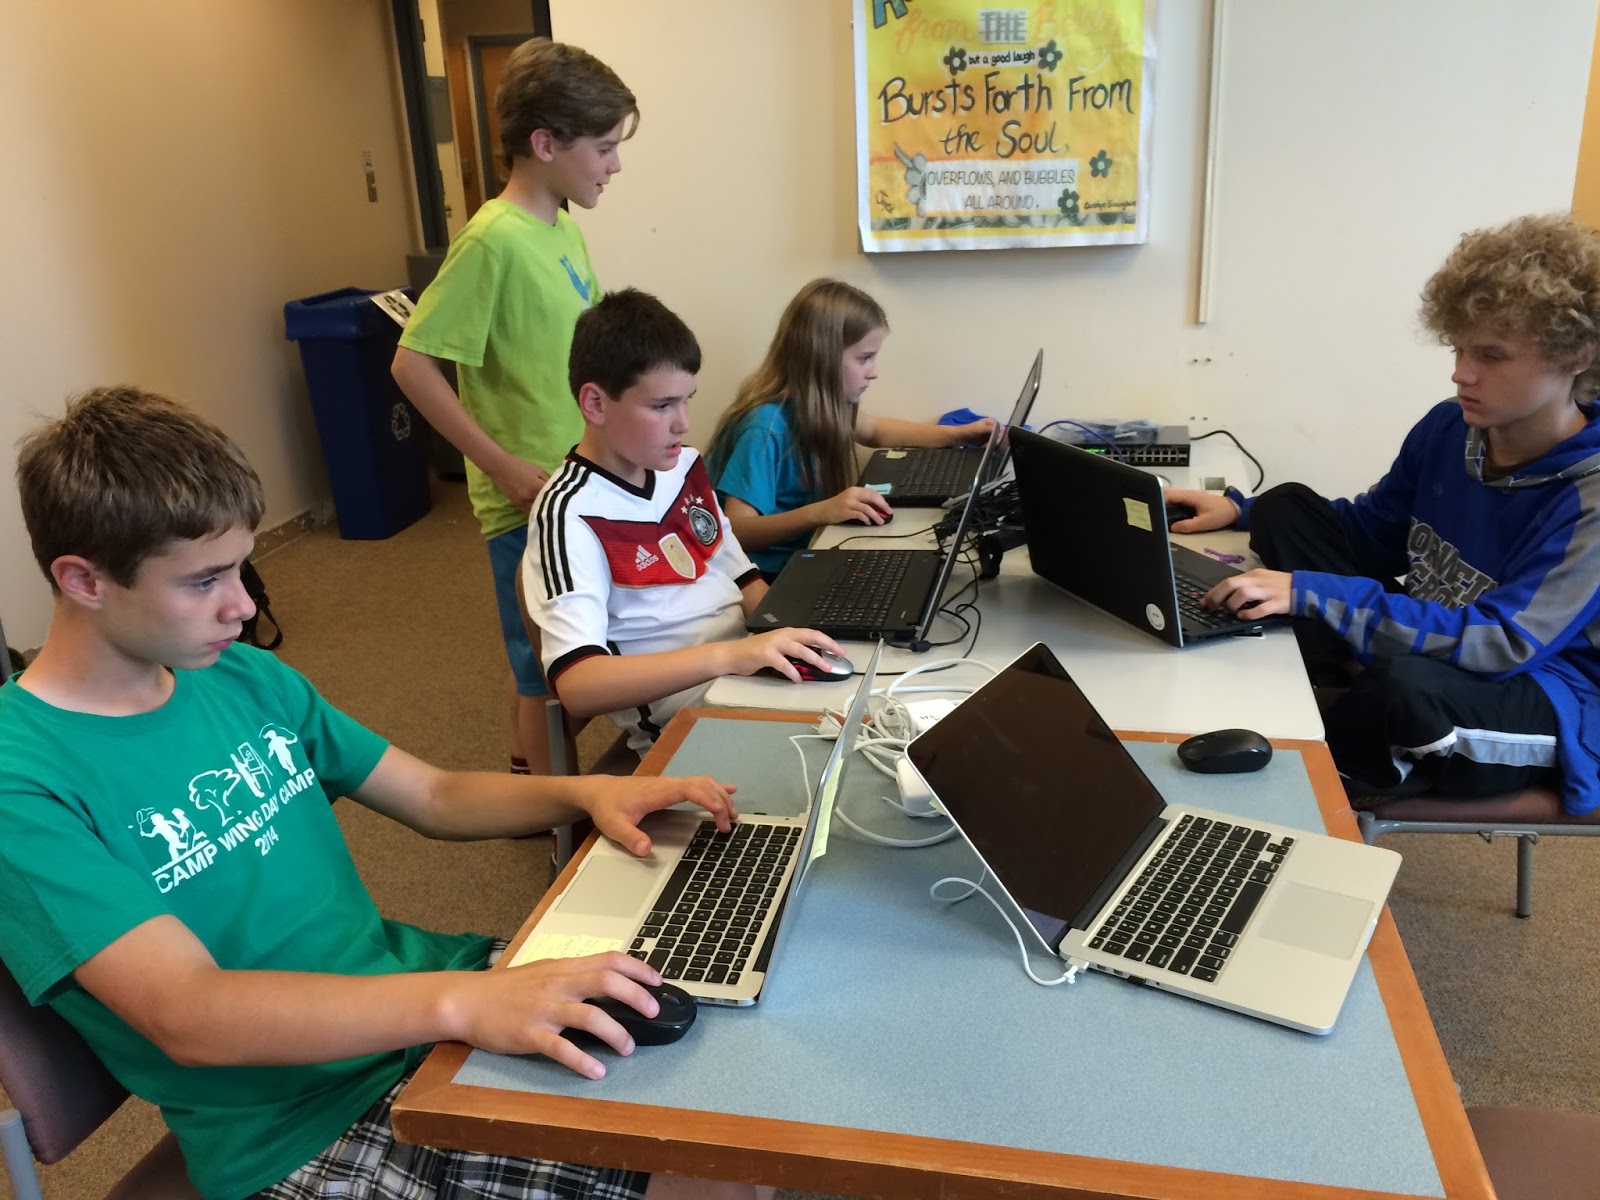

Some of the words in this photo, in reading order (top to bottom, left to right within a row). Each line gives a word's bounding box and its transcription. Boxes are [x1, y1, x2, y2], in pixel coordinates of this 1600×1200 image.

[979, 11, 1026, 42] THE
[982, 56, 989, 64] a
[991, 50, 1011, 67] good
[1013, 50, 1035, 64] laugh
[878, 77, 976, 123] Bursts
[984, 71, 1052, 116] Forth
[1068, 75, 1135, 115] From
[939, 123, 985, 155] the
[998, 170, 1022, 186] AND
[1024, 169, 1076, 185] BUBBLES
[964, 195, 984, 210] ALL
[154, 842, 218, 894] CAMP
[217, 810, 264, 852] WING
[259, 794, 280, 822] DAY
[279, 767, 315, 805] CAMP
[254, 825, 280, 857] 2014
